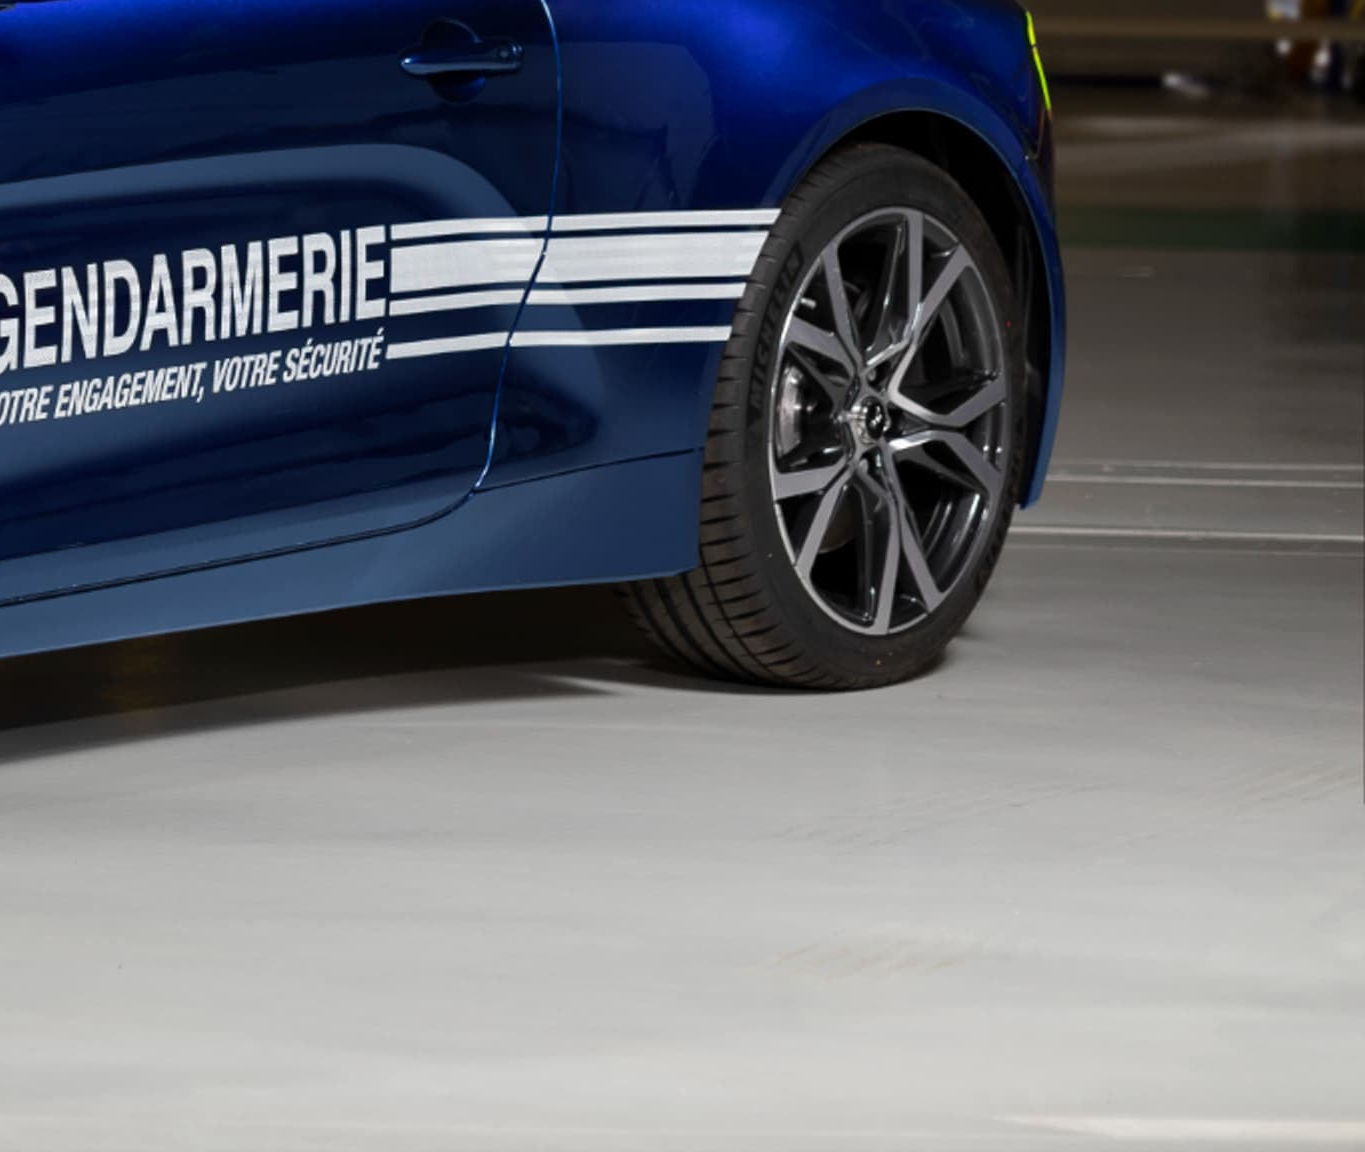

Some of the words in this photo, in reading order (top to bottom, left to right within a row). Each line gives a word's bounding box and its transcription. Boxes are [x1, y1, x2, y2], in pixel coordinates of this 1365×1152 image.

[53, 362, 207, 419] ENGAGEMENT,
[212, 351, 281, 394] VOTRE
[282, 332, 385, 383] SÉCURITÉ
